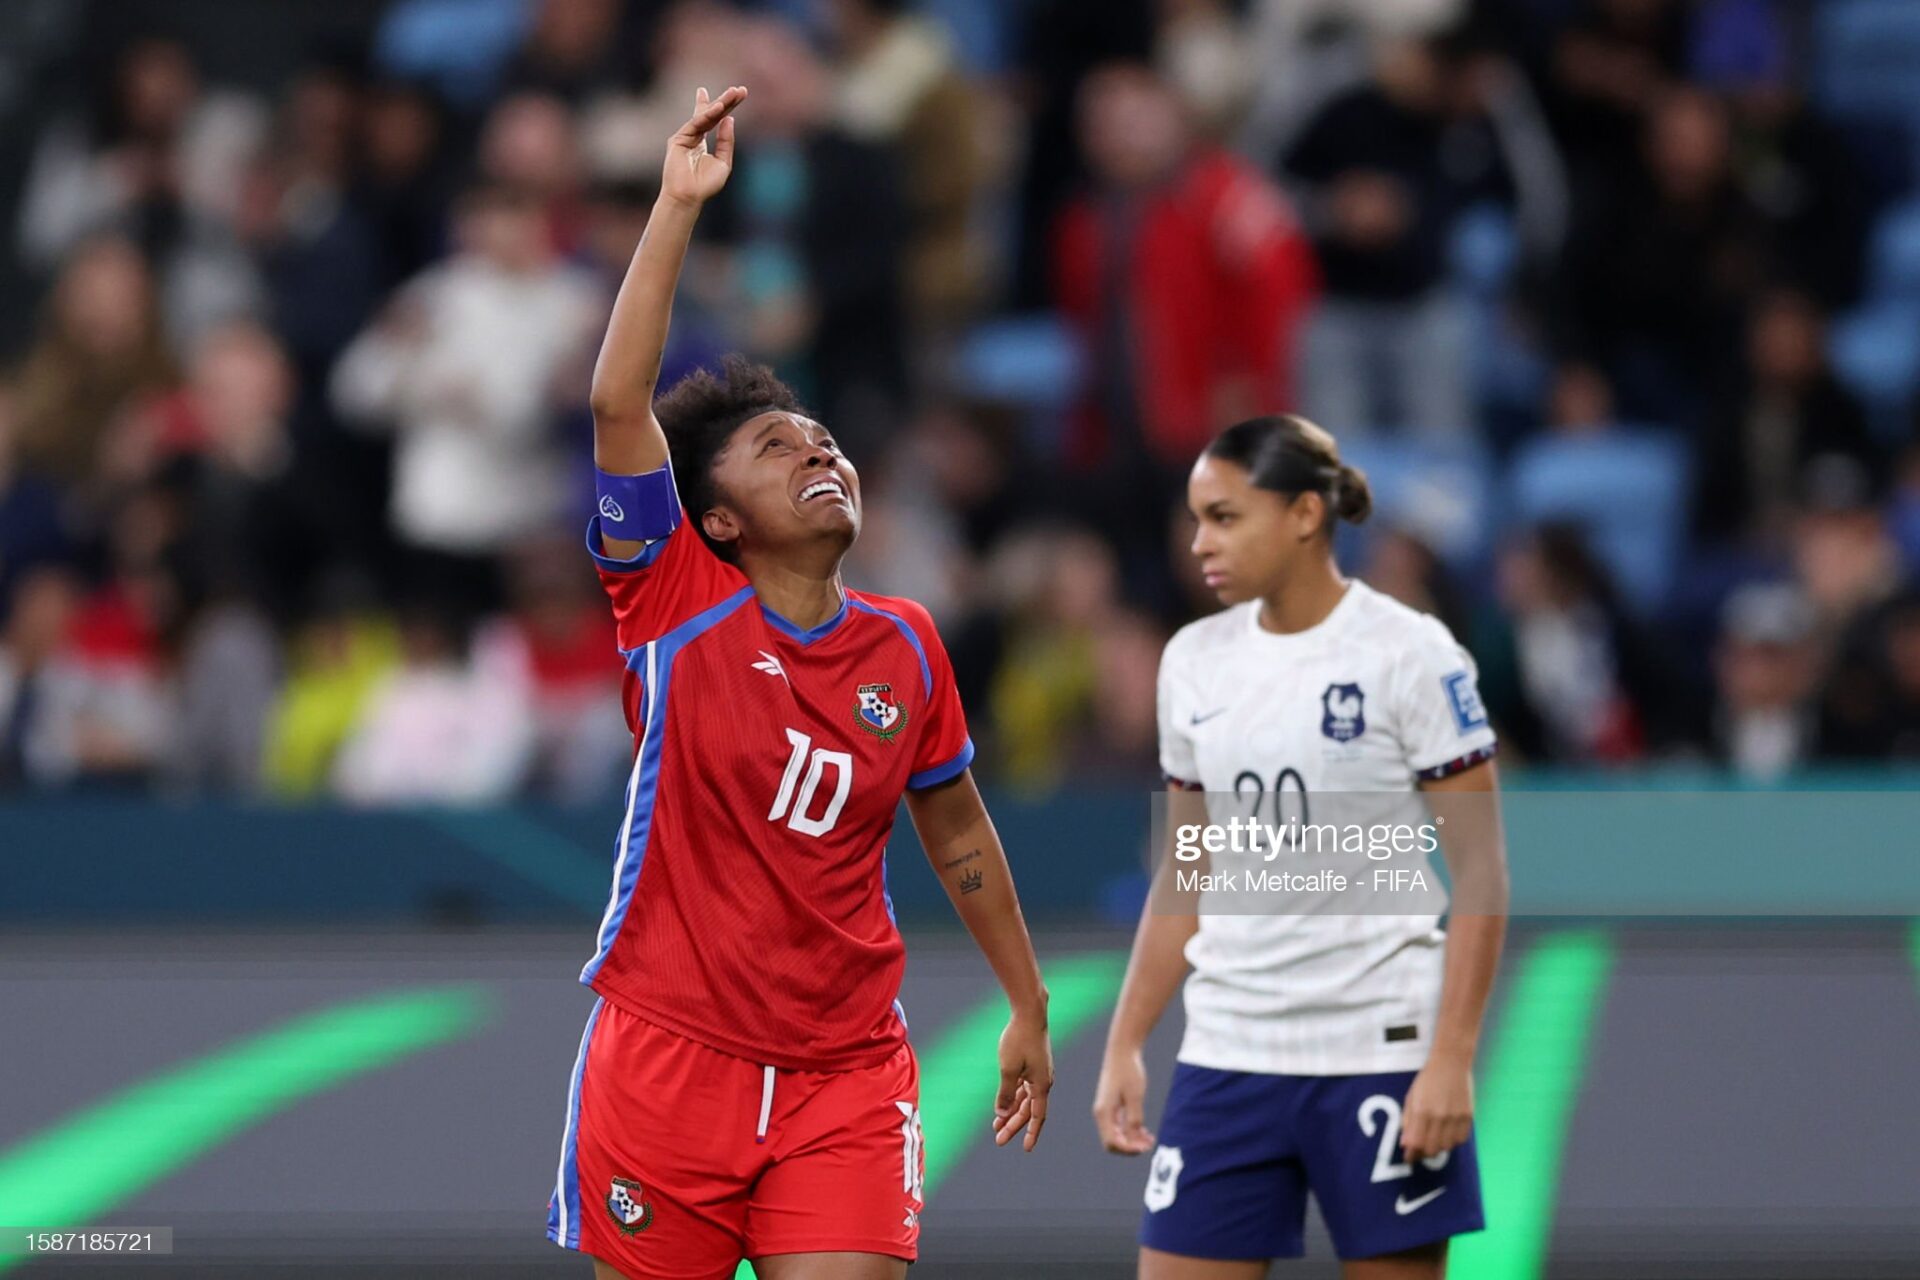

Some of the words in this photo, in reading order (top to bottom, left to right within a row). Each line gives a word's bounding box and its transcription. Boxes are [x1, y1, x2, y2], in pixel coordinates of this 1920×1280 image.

[767, 727, 853, 838] 10
[1234, 767, 1310, 850] 20
[1357, 1094, 1451, 1183] 2
